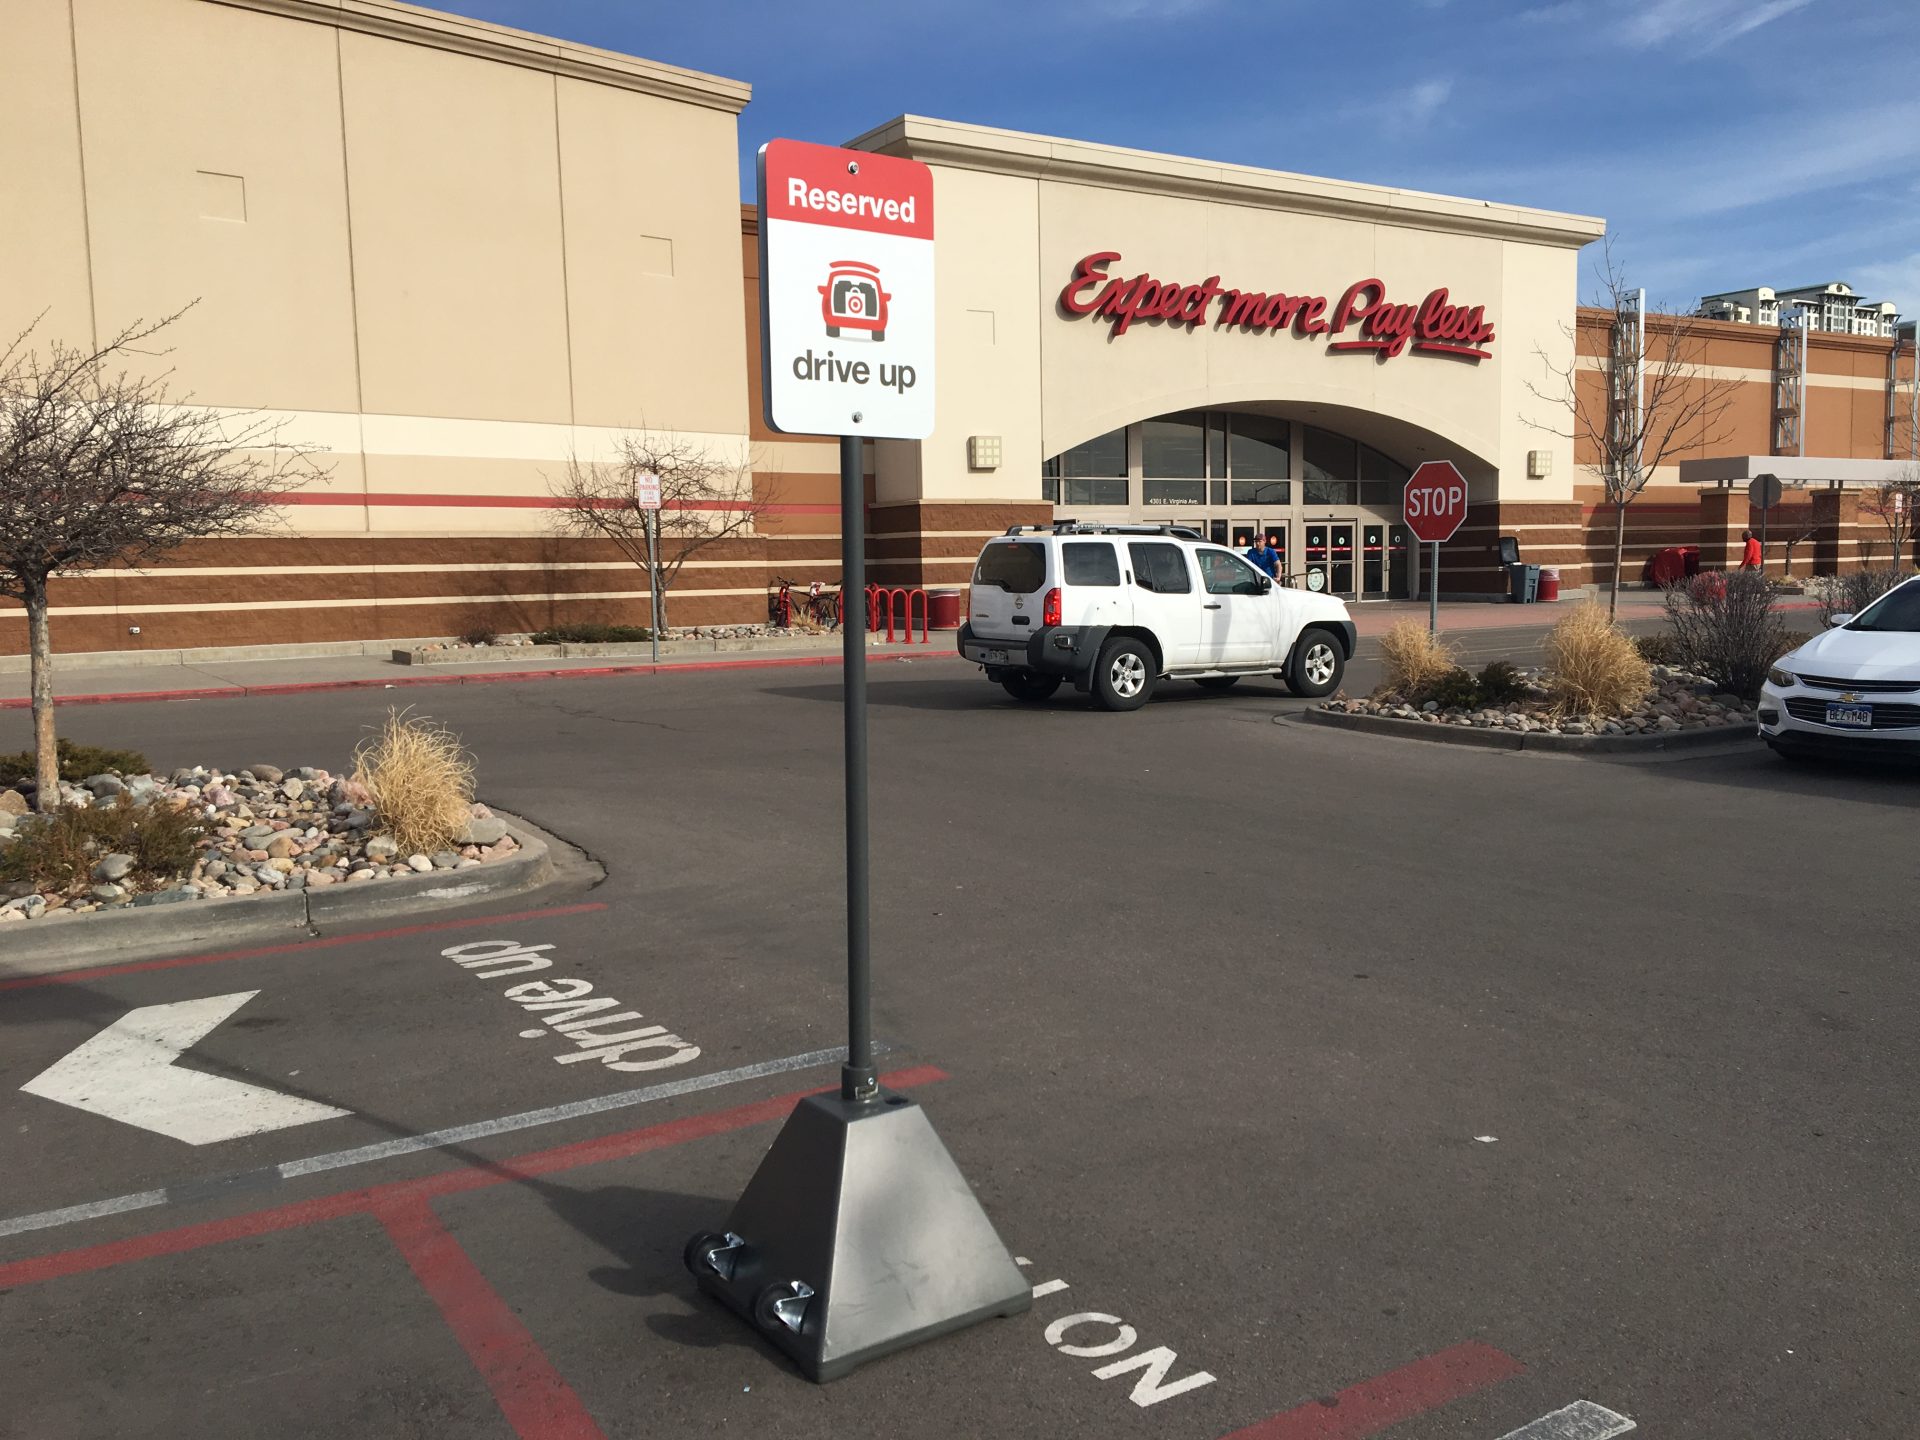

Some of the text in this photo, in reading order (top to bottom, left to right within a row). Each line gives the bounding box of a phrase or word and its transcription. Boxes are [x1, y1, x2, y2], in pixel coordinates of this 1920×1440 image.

[788, 177, 915, 223] Reserved
[1063, 251, 1224, 336] Expect
[1331, 278, 1417, 358] Pay
[793, 349, 916, 394] drive up
[1408, 487, 1462, 517] STOP
[441, 940, 701, 1071] drive up
[1044, 1312, 1217, 1407] NO
